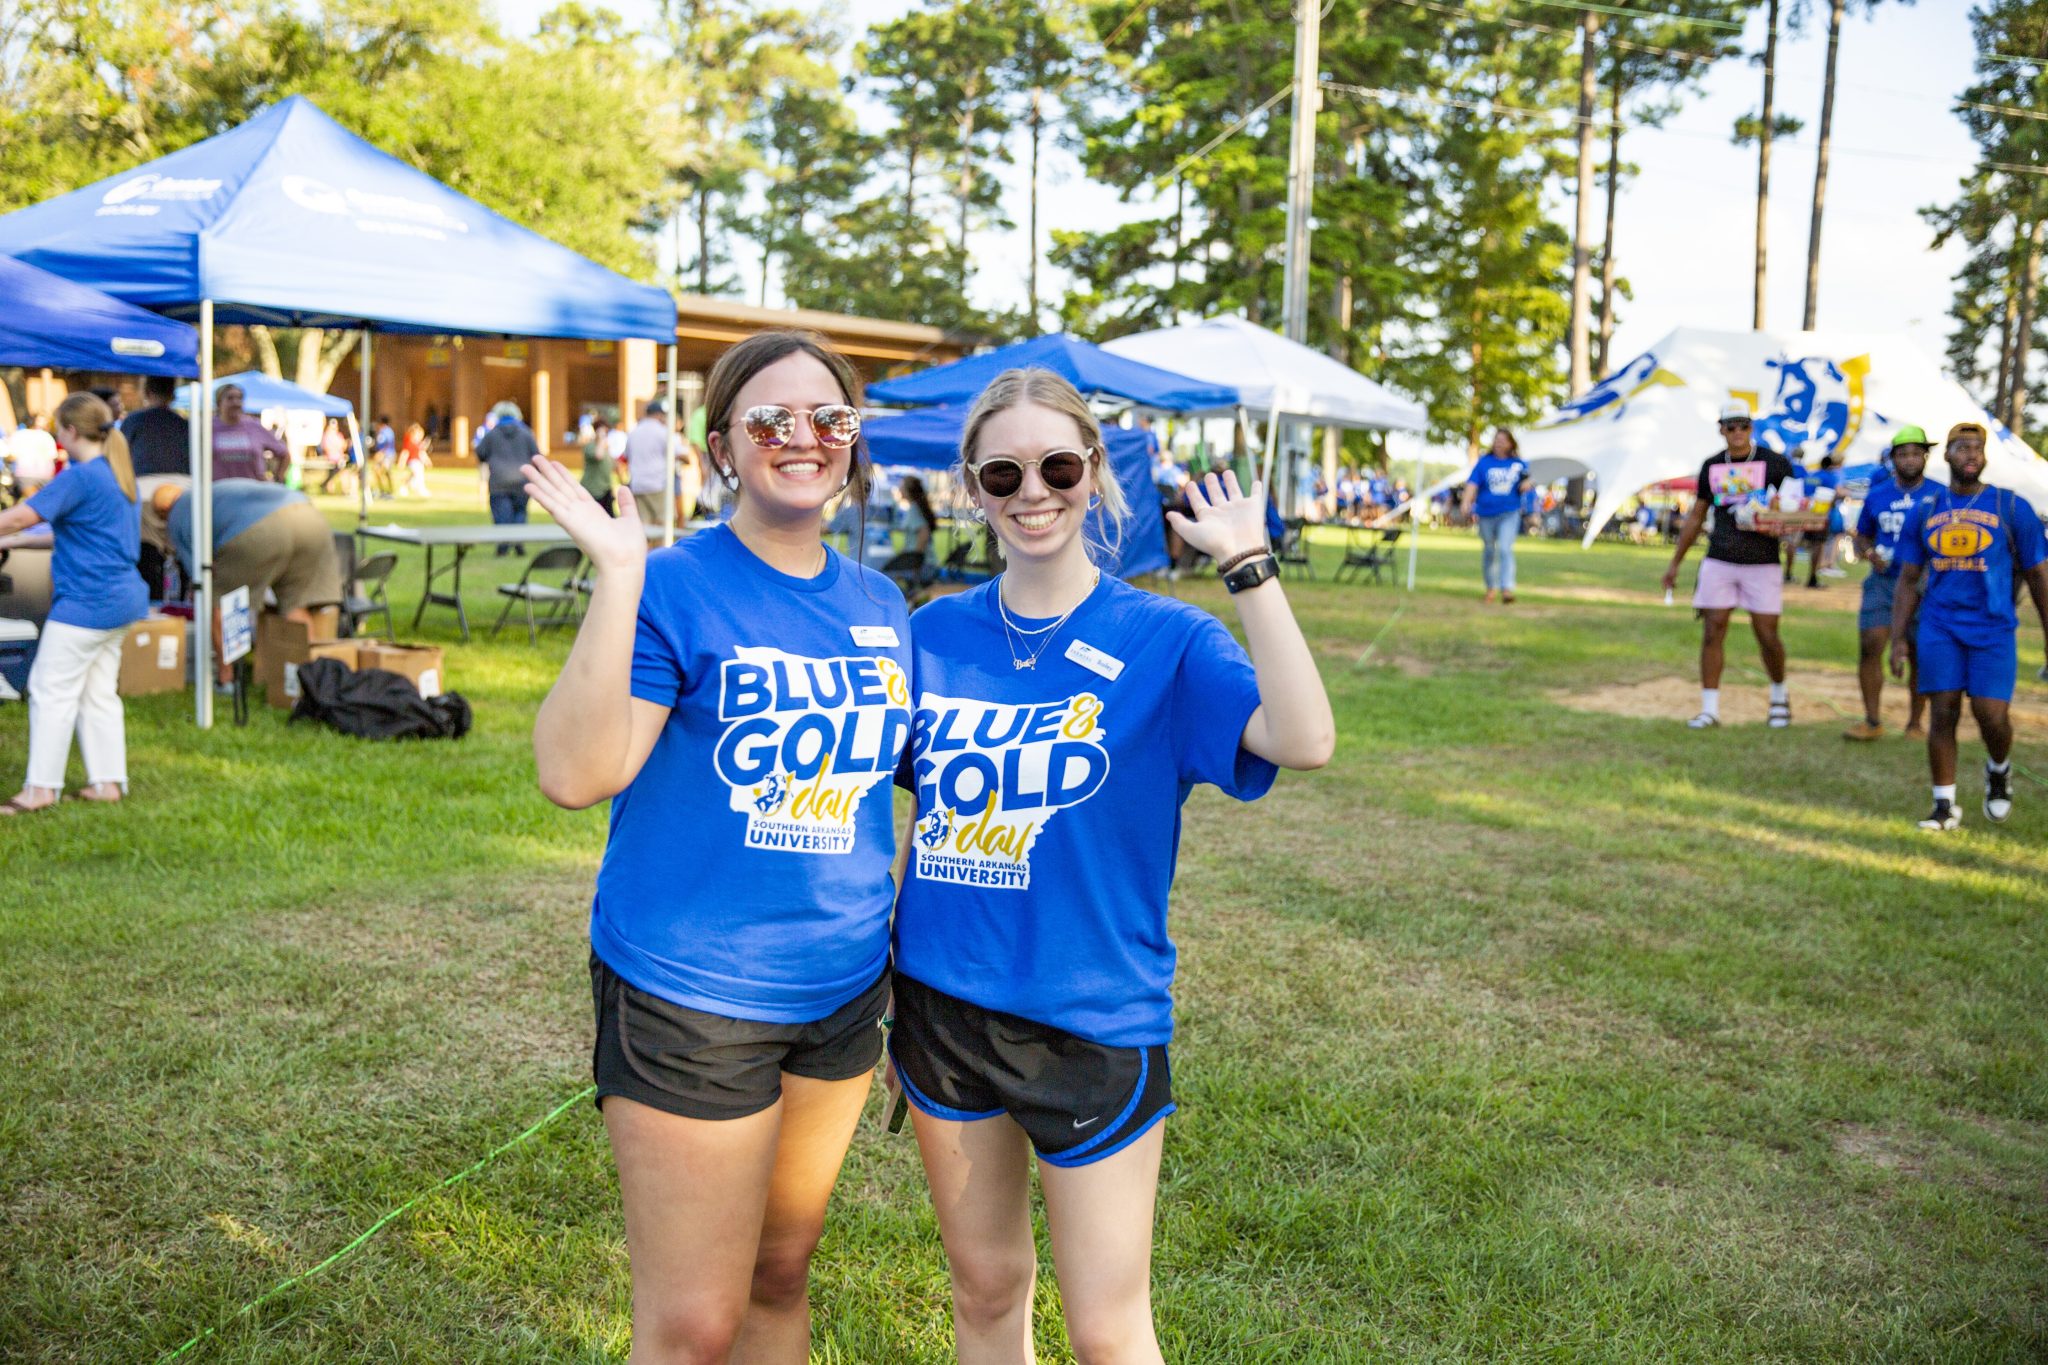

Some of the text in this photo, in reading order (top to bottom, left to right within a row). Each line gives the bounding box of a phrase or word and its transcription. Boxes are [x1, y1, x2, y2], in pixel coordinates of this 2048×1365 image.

[717, 708, 911, 786] GOLD
[791, 752, 860, 826] day
[753, 820, 852, 835] SOUTHERN ARKANSAS
[956, 789, 1035, 863] day
[750, 829, 850, 851] UNIVERSITY
[919, 862, 1027, 887] UNIVERSITY
[921, 854, 1028, 872] SOUTHERN ARKANSAS
